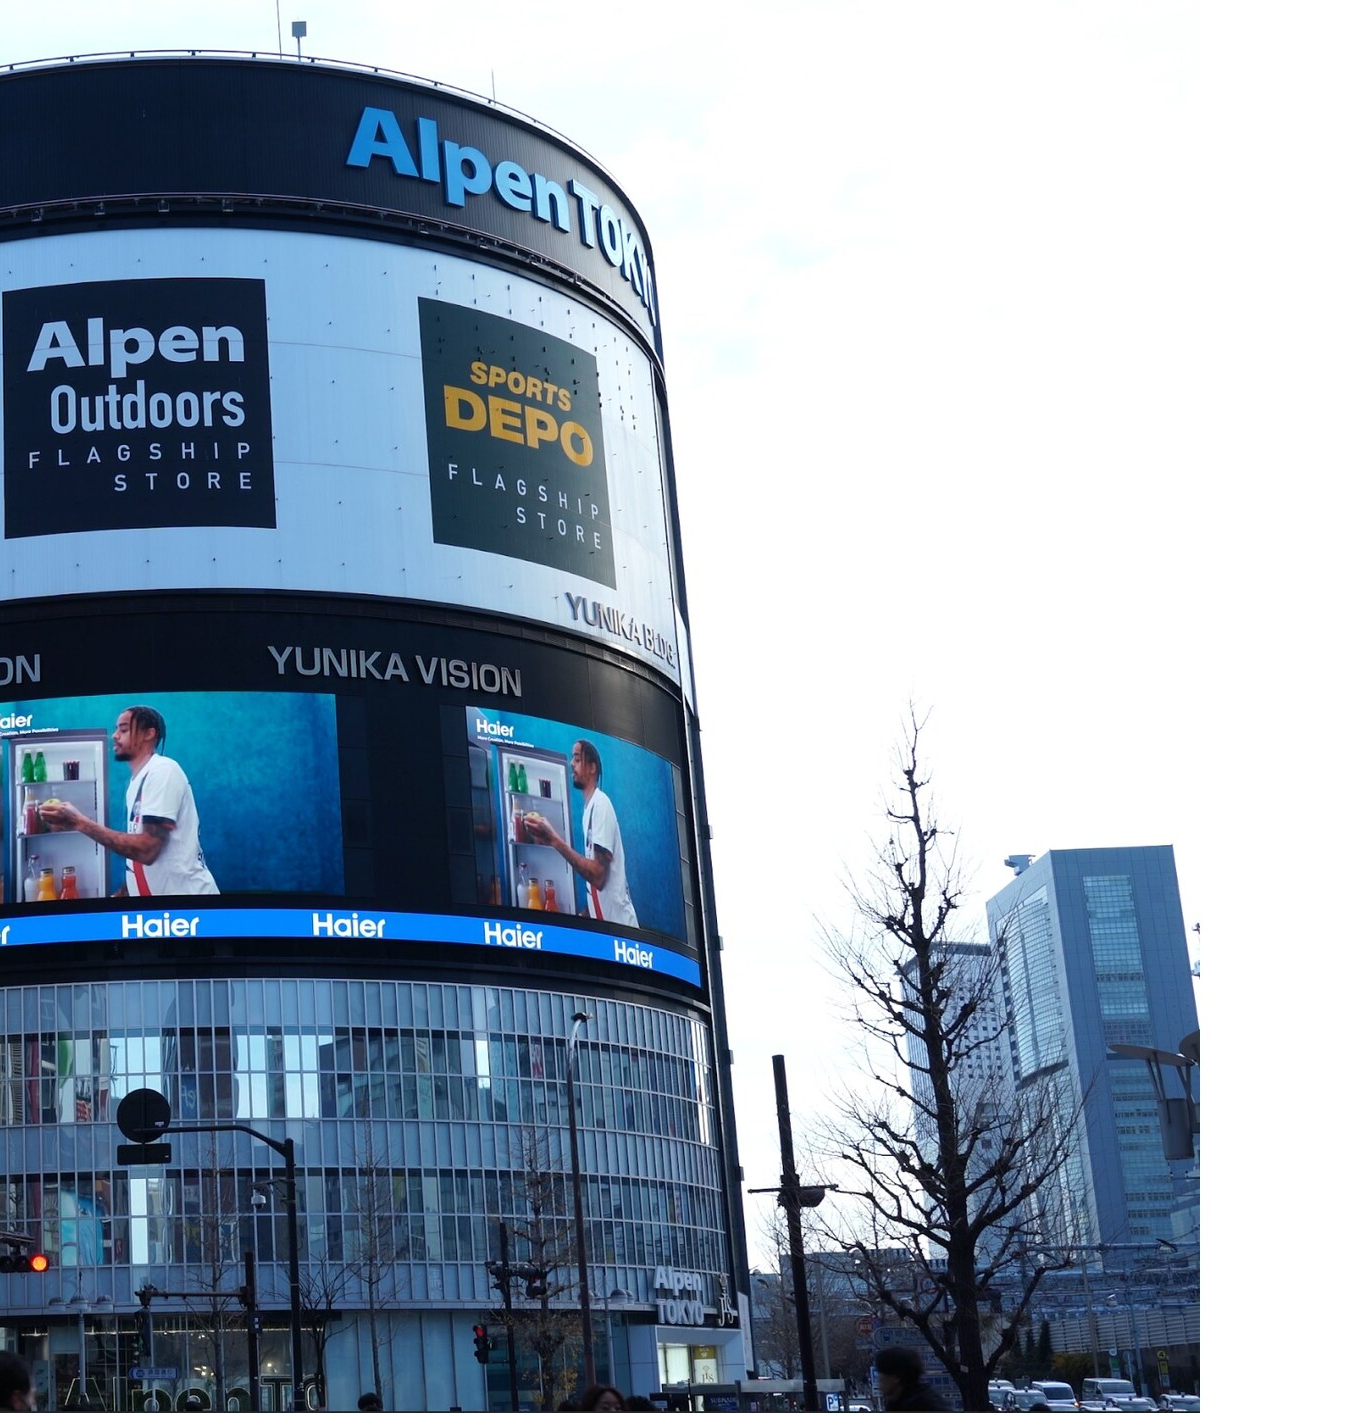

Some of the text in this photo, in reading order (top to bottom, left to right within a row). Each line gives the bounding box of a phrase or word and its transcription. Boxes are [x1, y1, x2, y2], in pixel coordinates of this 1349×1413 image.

[346, 106, 571, 234] Alpen
[26, 317, 245, 379] Alpen
[50, 379, 246, 434] Outdoors
[469, 360, 572, 412] SPORTS
[443, 384, 594, 467] DEPO
[29, 442, 250, 469] FLAGSHIP
[114, 472, 252, 492] STORE
[448, 463, 599, 521] FLAGSHIP
[516, 506, 602, 550] STORE
[566, 591, 677, 671] YUNIKA BLDG.
[267, 645, 523, 698] YUNIKA VISION
[476, 718, 514, 738] Haier
[121, 912, 200, 939] Haier
[312, 912, 386, 939] Haier
[484, 921, 543, 951] Haier
[613, 938, 654, 970] Haier
[655, 1265, 702, 1297] Alpen
[656, 1298, 705, 1326] TOKYO
